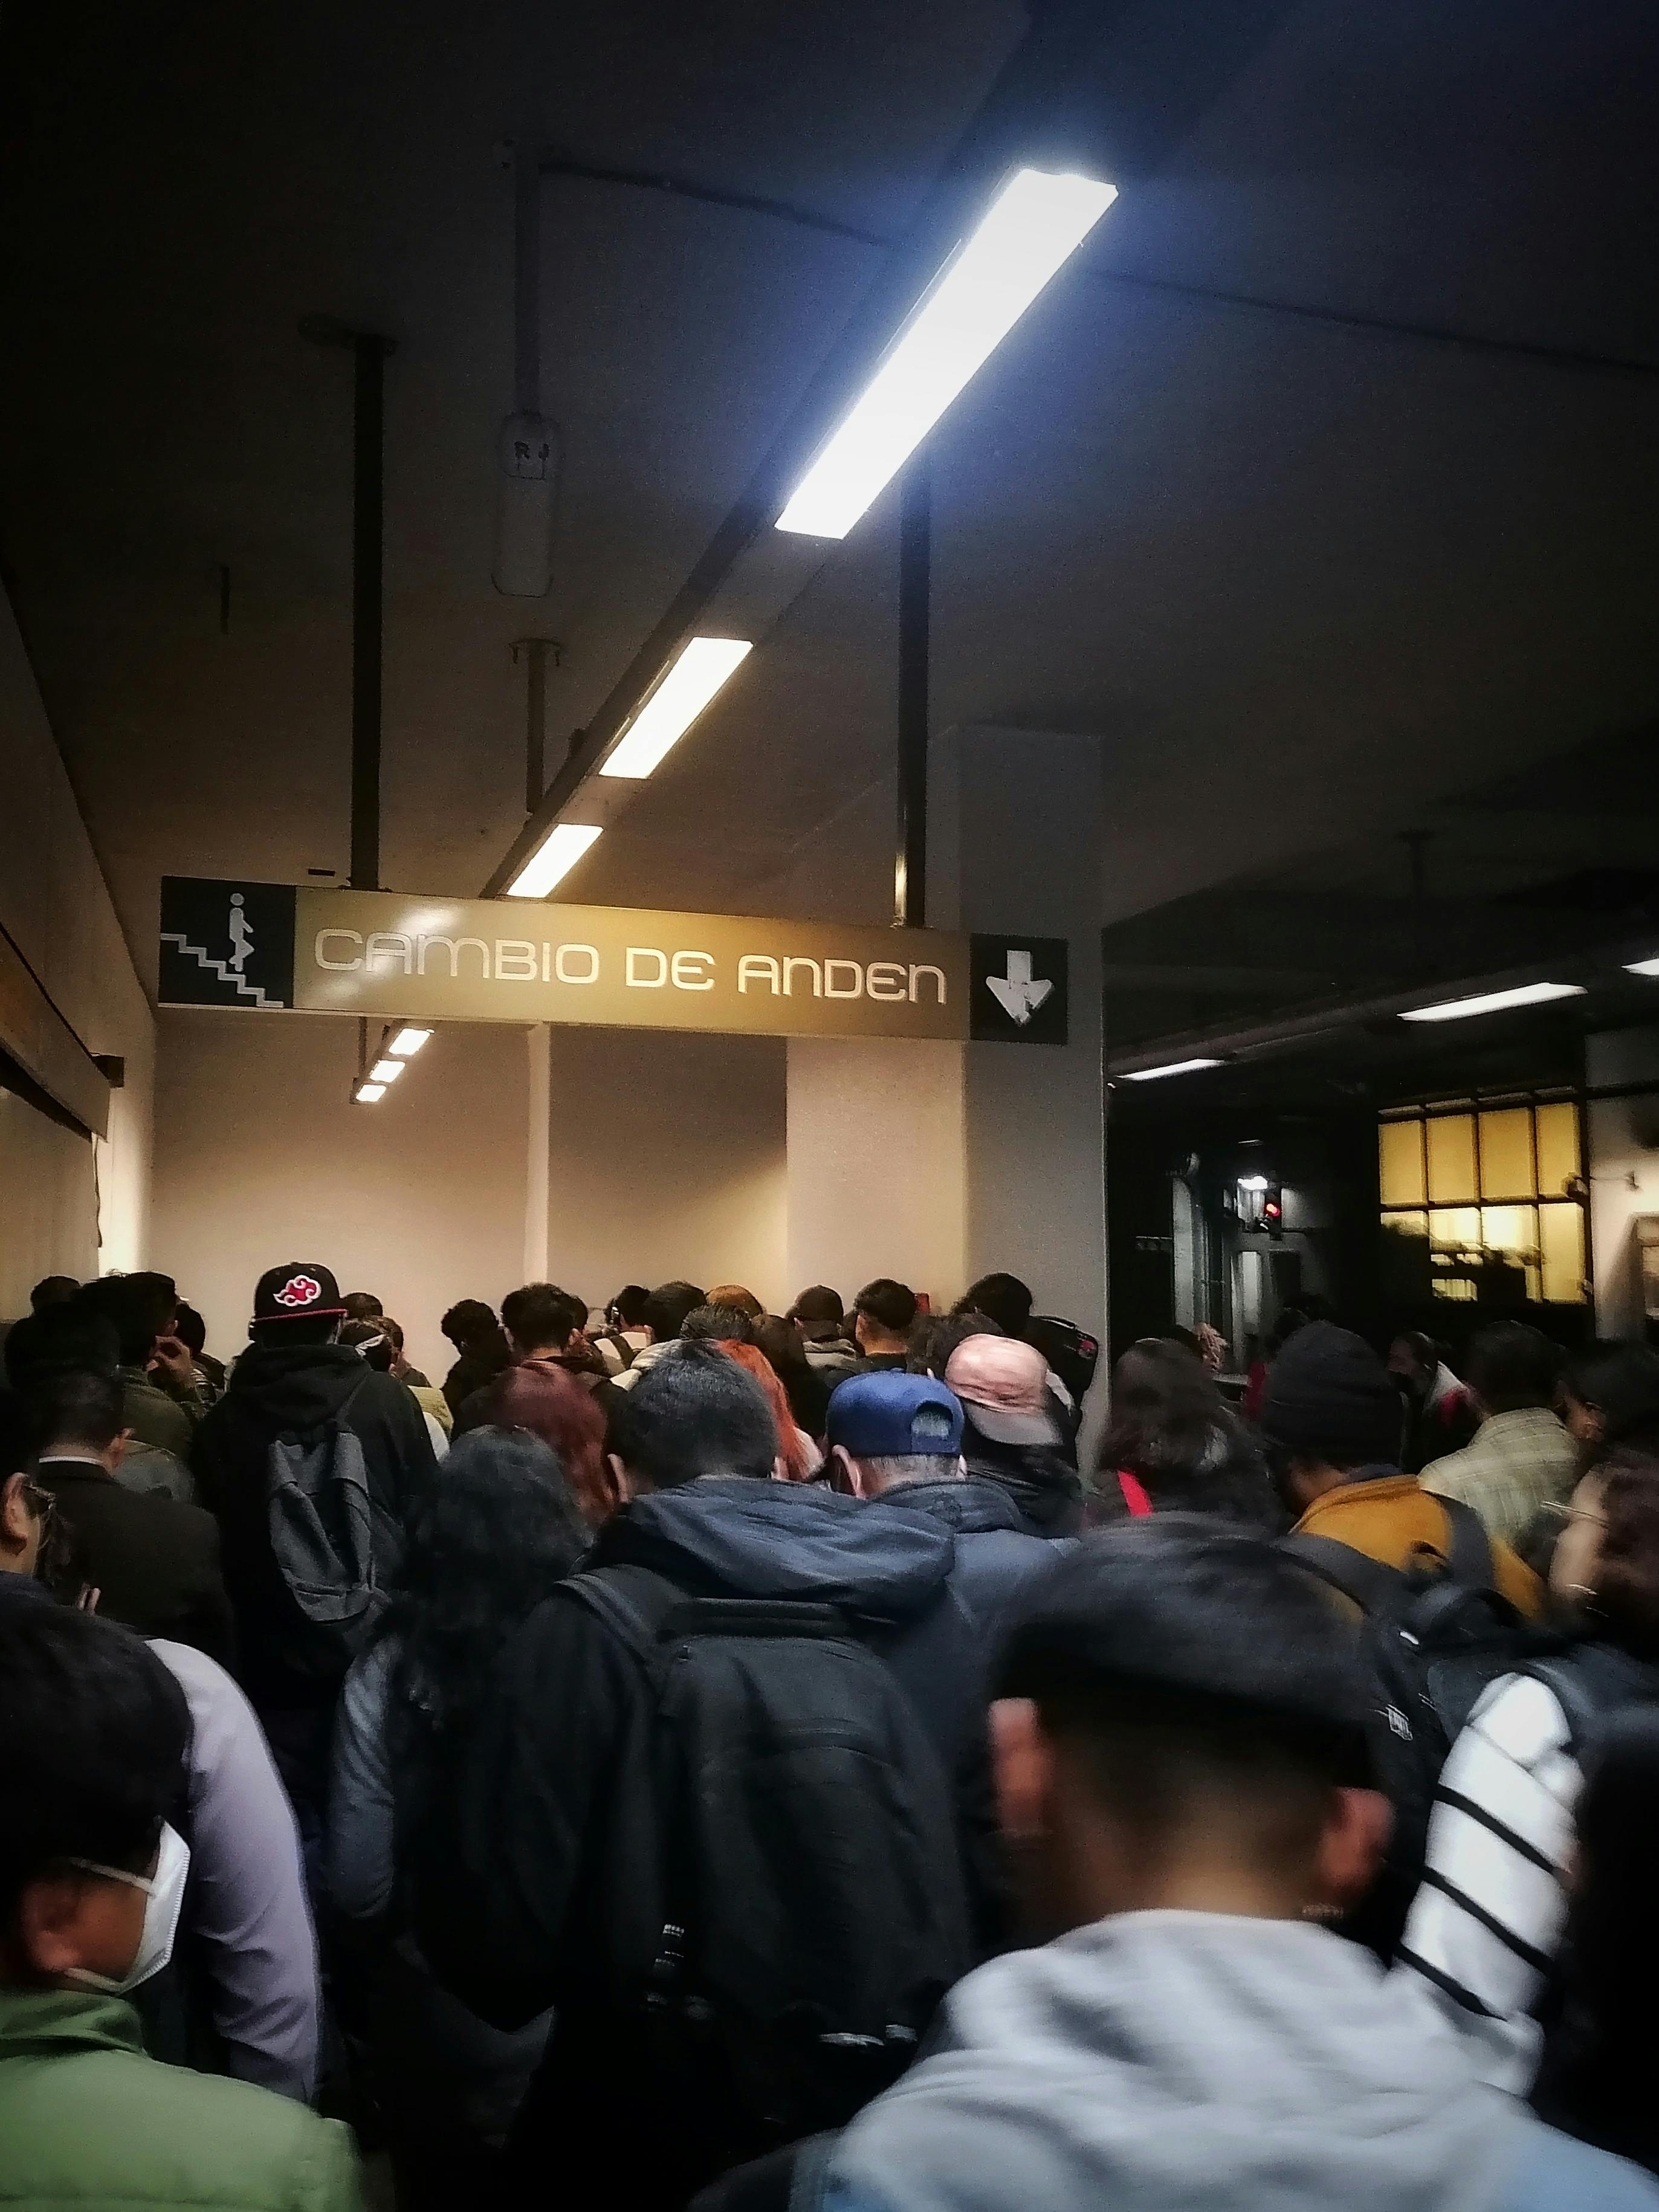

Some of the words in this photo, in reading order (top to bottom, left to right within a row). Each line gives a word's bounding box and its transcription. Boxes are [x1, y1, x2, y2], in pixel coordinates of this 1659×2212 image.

[315, 928, 600, 984] CAMBIO
[626, 947, 715, 990] DE
[737, 954, 946, 1004] ANDEN
